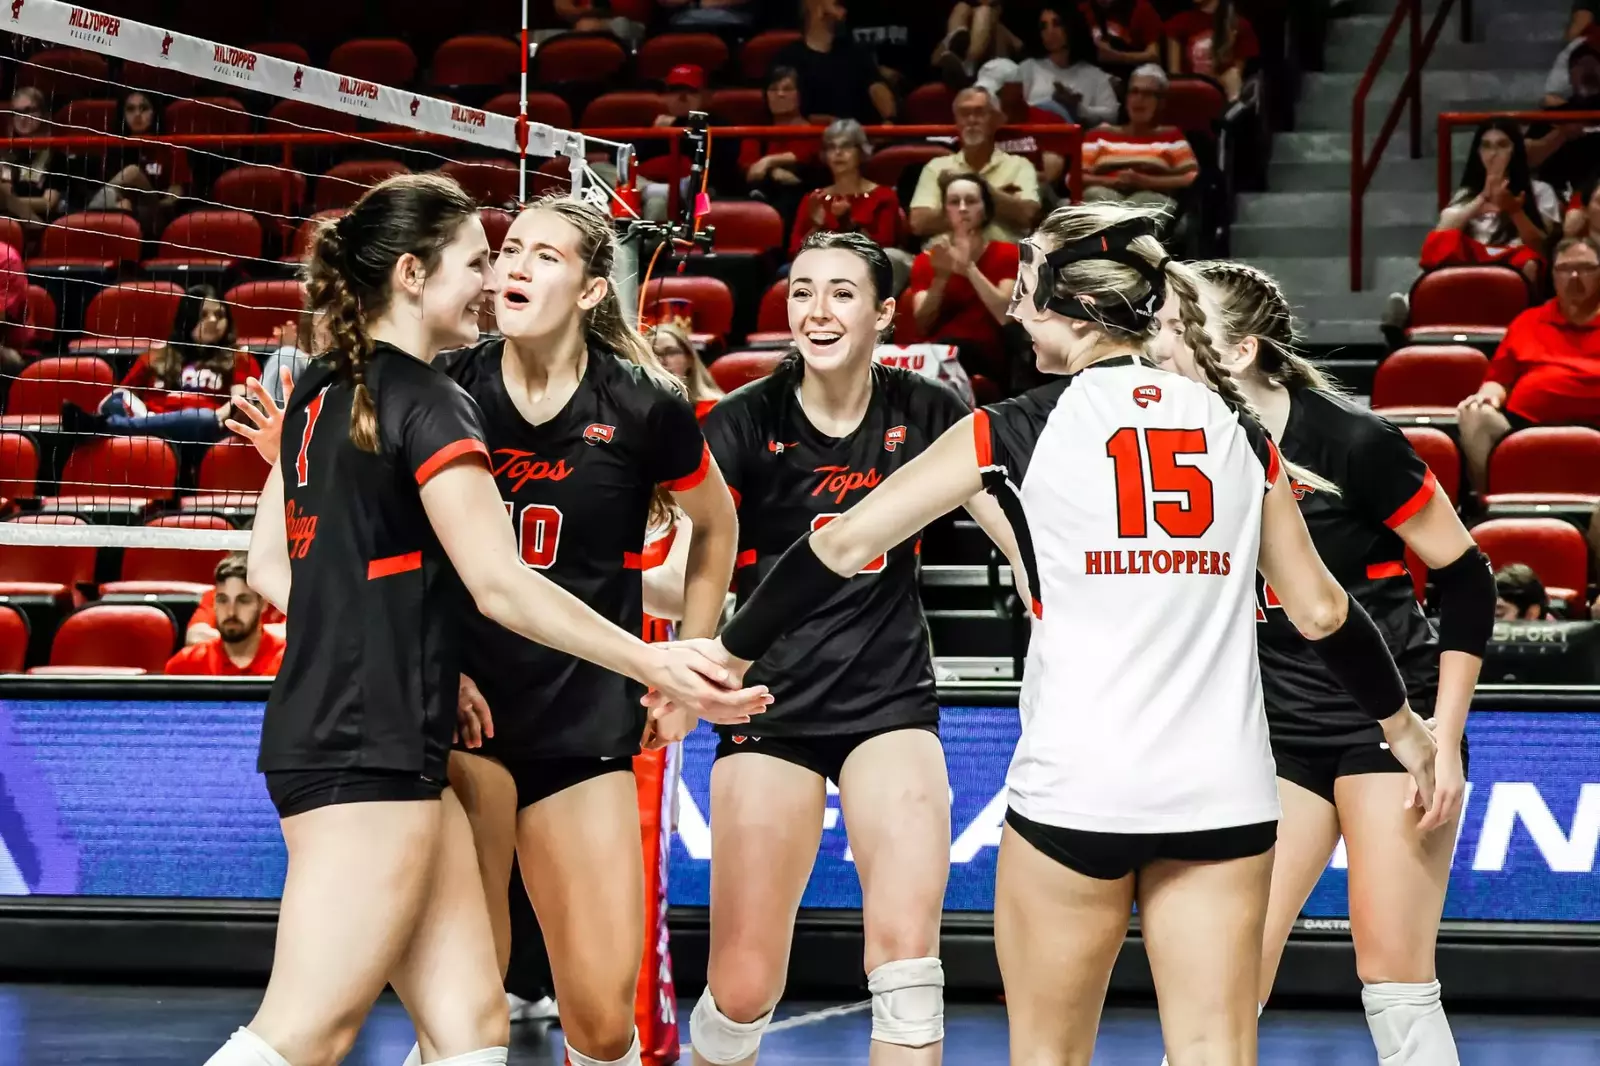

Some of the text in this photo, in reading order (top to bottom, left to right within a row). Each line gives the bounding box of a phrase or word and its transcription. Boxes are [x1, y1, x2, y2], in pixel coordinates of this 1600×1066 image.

[69, 7, 120, 37] HILLTOPPER
[213, 44, 257, 71] HILLTOPPER
[880, 355, 925, 370] WKU
[493, 448, 574, 493] Tops
[811, 465, 882, 504] Tops
[1105, 427, 1214, 538] 15
[1085, 550, 1231, 576] HILLTOPPERS
[1304, 919, 1350, 930] DAKTR
